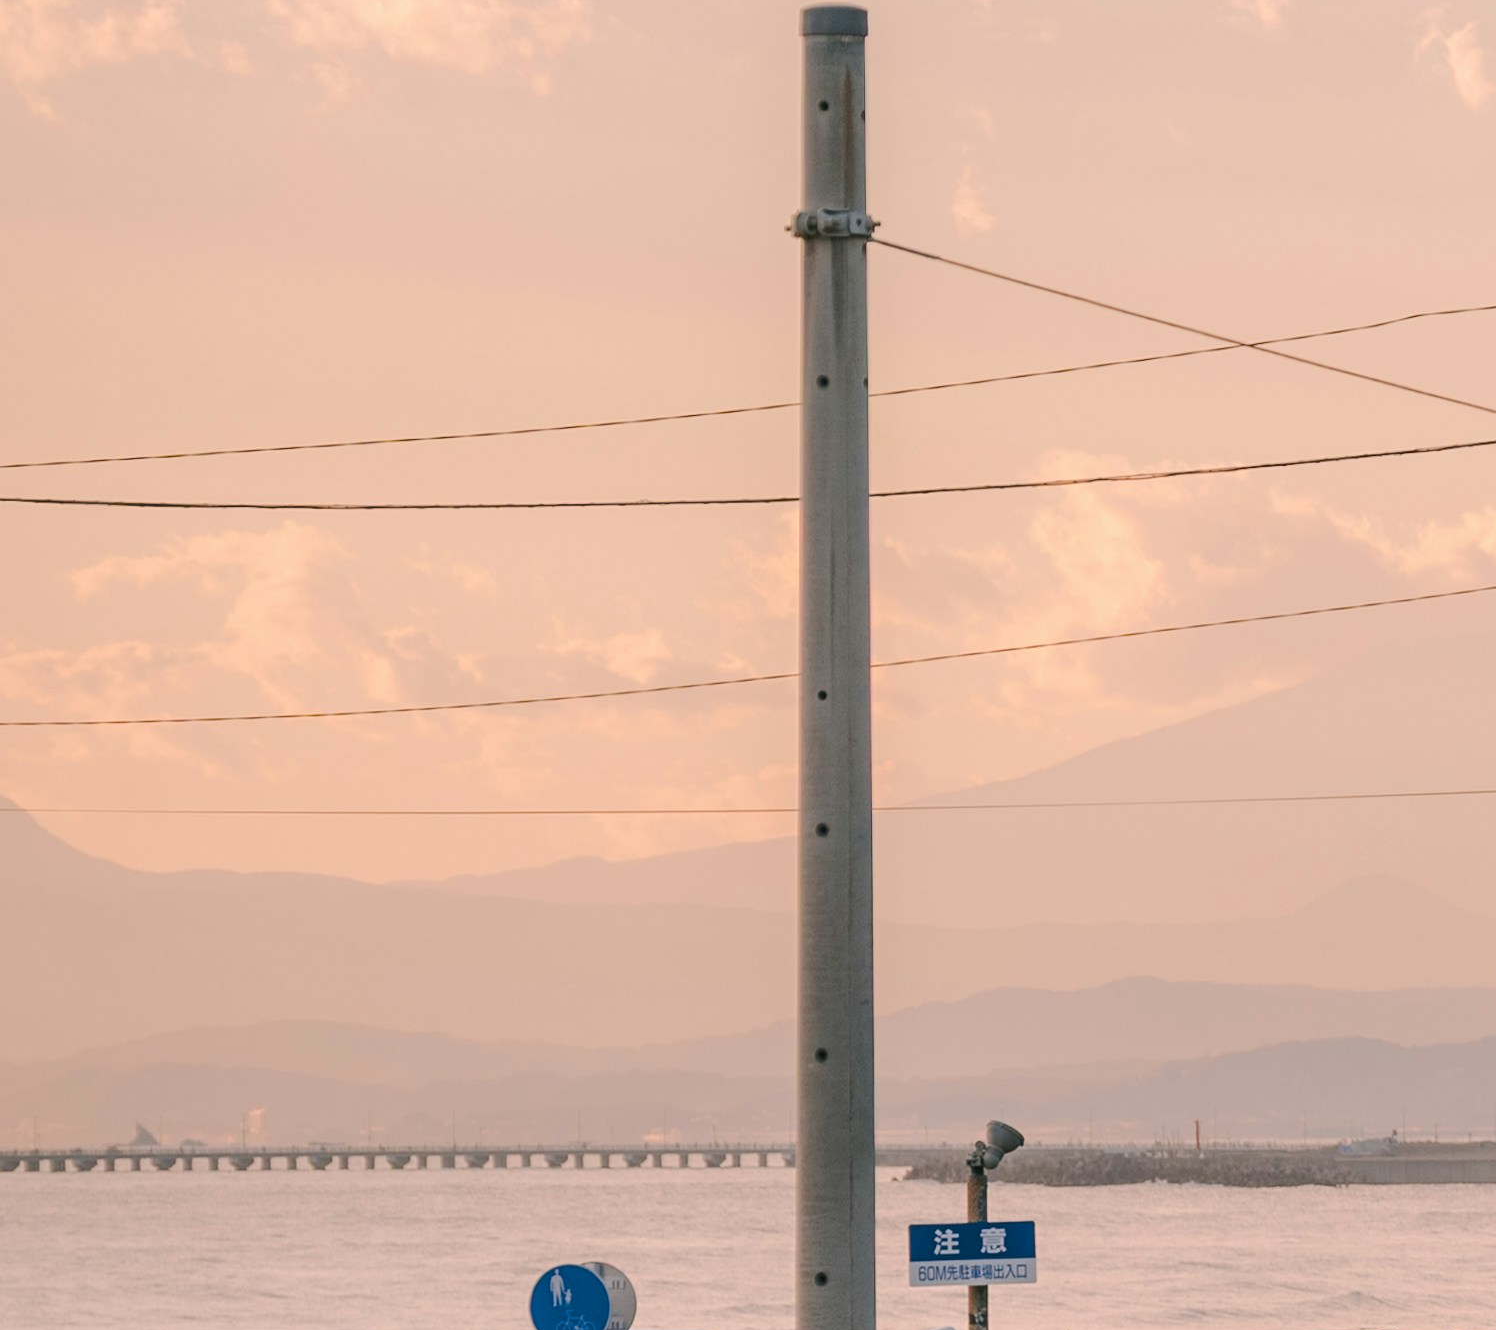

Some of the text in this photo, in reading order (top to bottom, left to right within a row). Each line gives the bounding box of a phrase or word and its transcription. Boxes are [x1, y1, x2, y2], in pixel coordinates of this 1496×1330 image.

[919, 1264, 1027, 1281] 60M先駐車場出入口
